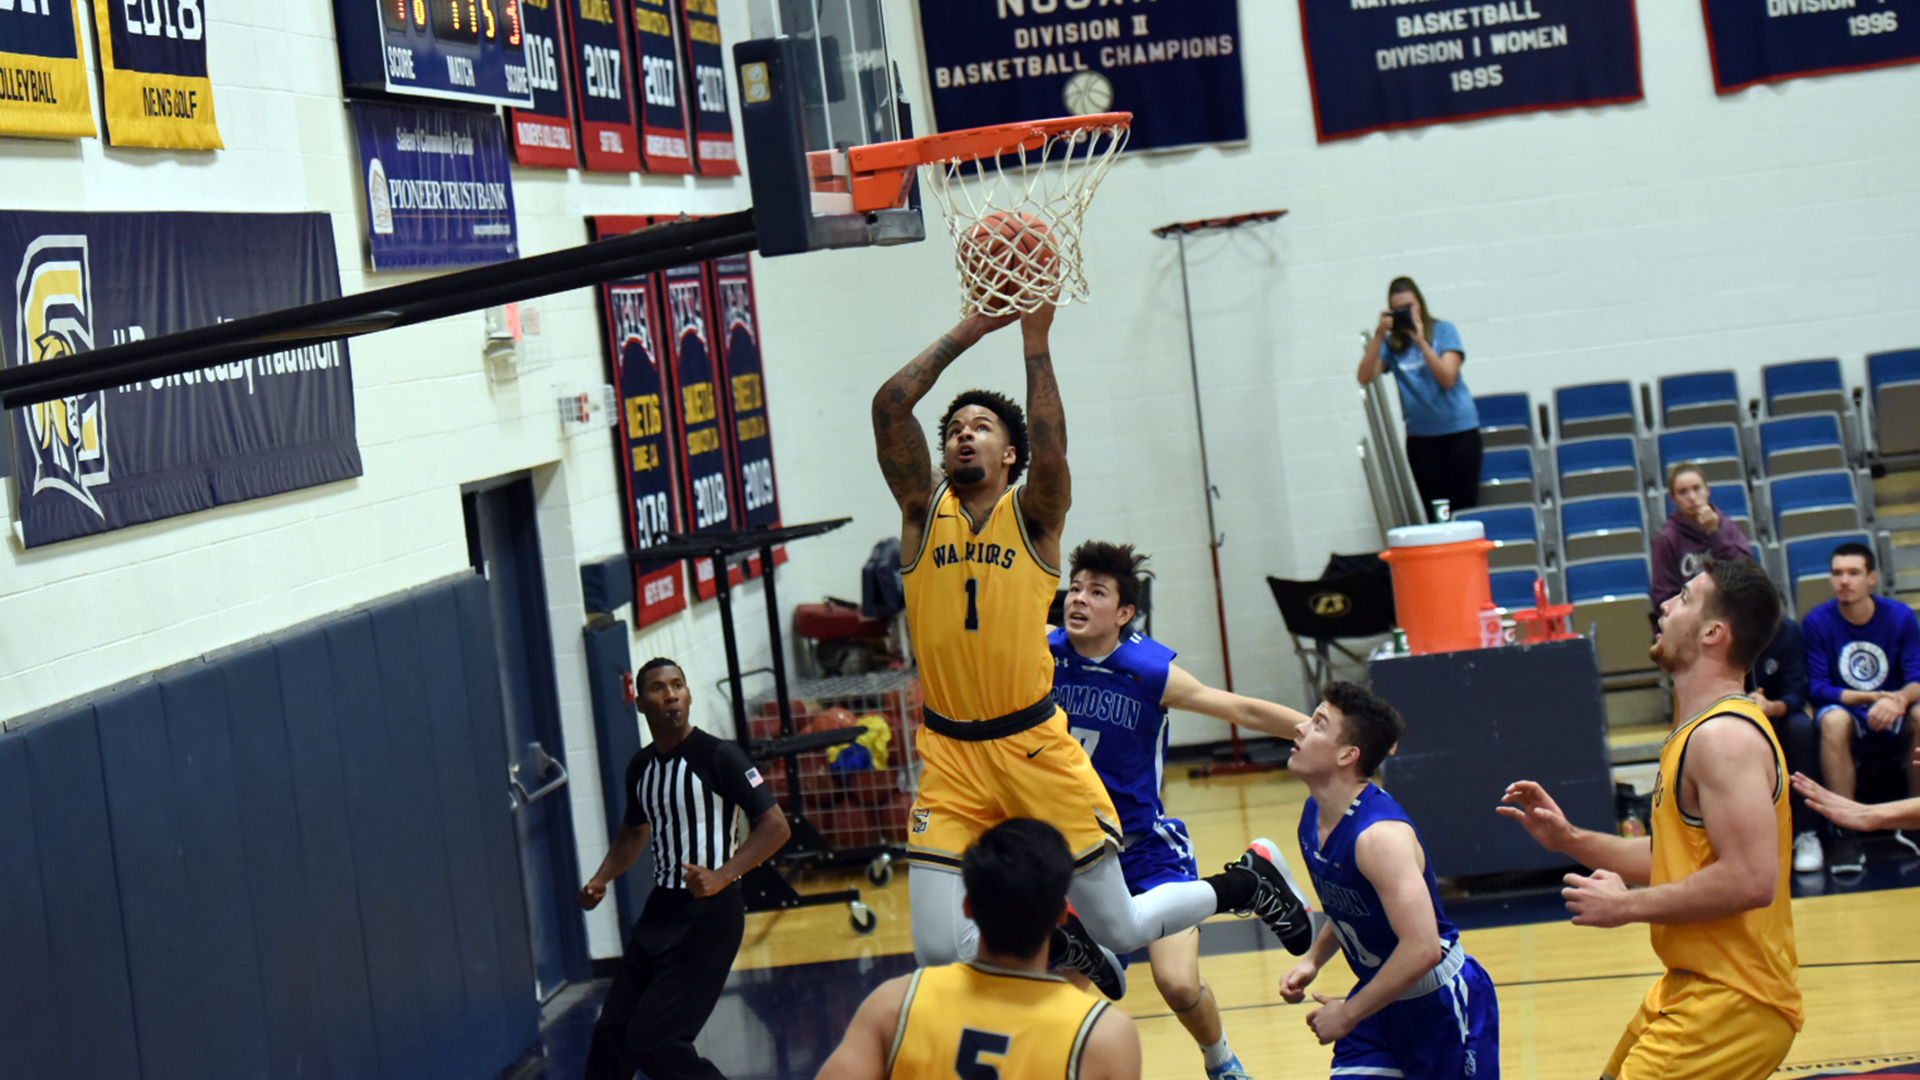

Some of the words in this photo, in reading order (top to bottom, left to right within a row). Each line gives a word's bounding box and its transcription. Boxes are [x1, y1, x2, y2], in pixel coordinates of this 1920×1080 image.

[1014, 19, 1119, 49] DIVISION
[1396, 3, 1541, 38] BASKETBALL
[1847, 11, 1898, 36] 1996
[387, 46, 416, 79] SCORE
[526, 33, 558, 91] 016
[935, 52, 1088, 89] BASKETBALL
[1100, 35, 1233, 68] CHAMPIONS
[1375, 40, 1464, 71] DIVISION
[1490, 25, 1569, 55] WOMEN
[0, 67, 57, 104] OLLEYBALL
[446, 55, 476, 87] MATCH
[504, 64, 529, 94] SCORE
[584, 44, 621, 100] 2017
[642, 55, 675, 107] 2017
[1450, 65, 1503, 92] 1995
[389, 178, 443, 210] PIONEER
[441, 181, 477, 210] TRUST
[475, 182, 508, 210] BANK
[694, 472, 727, 529] 2018
[932, 541, 1016, 569] WARIORS
[964, 577, 979, 632] 1
[954, 1027, 1011, 1080] 5
